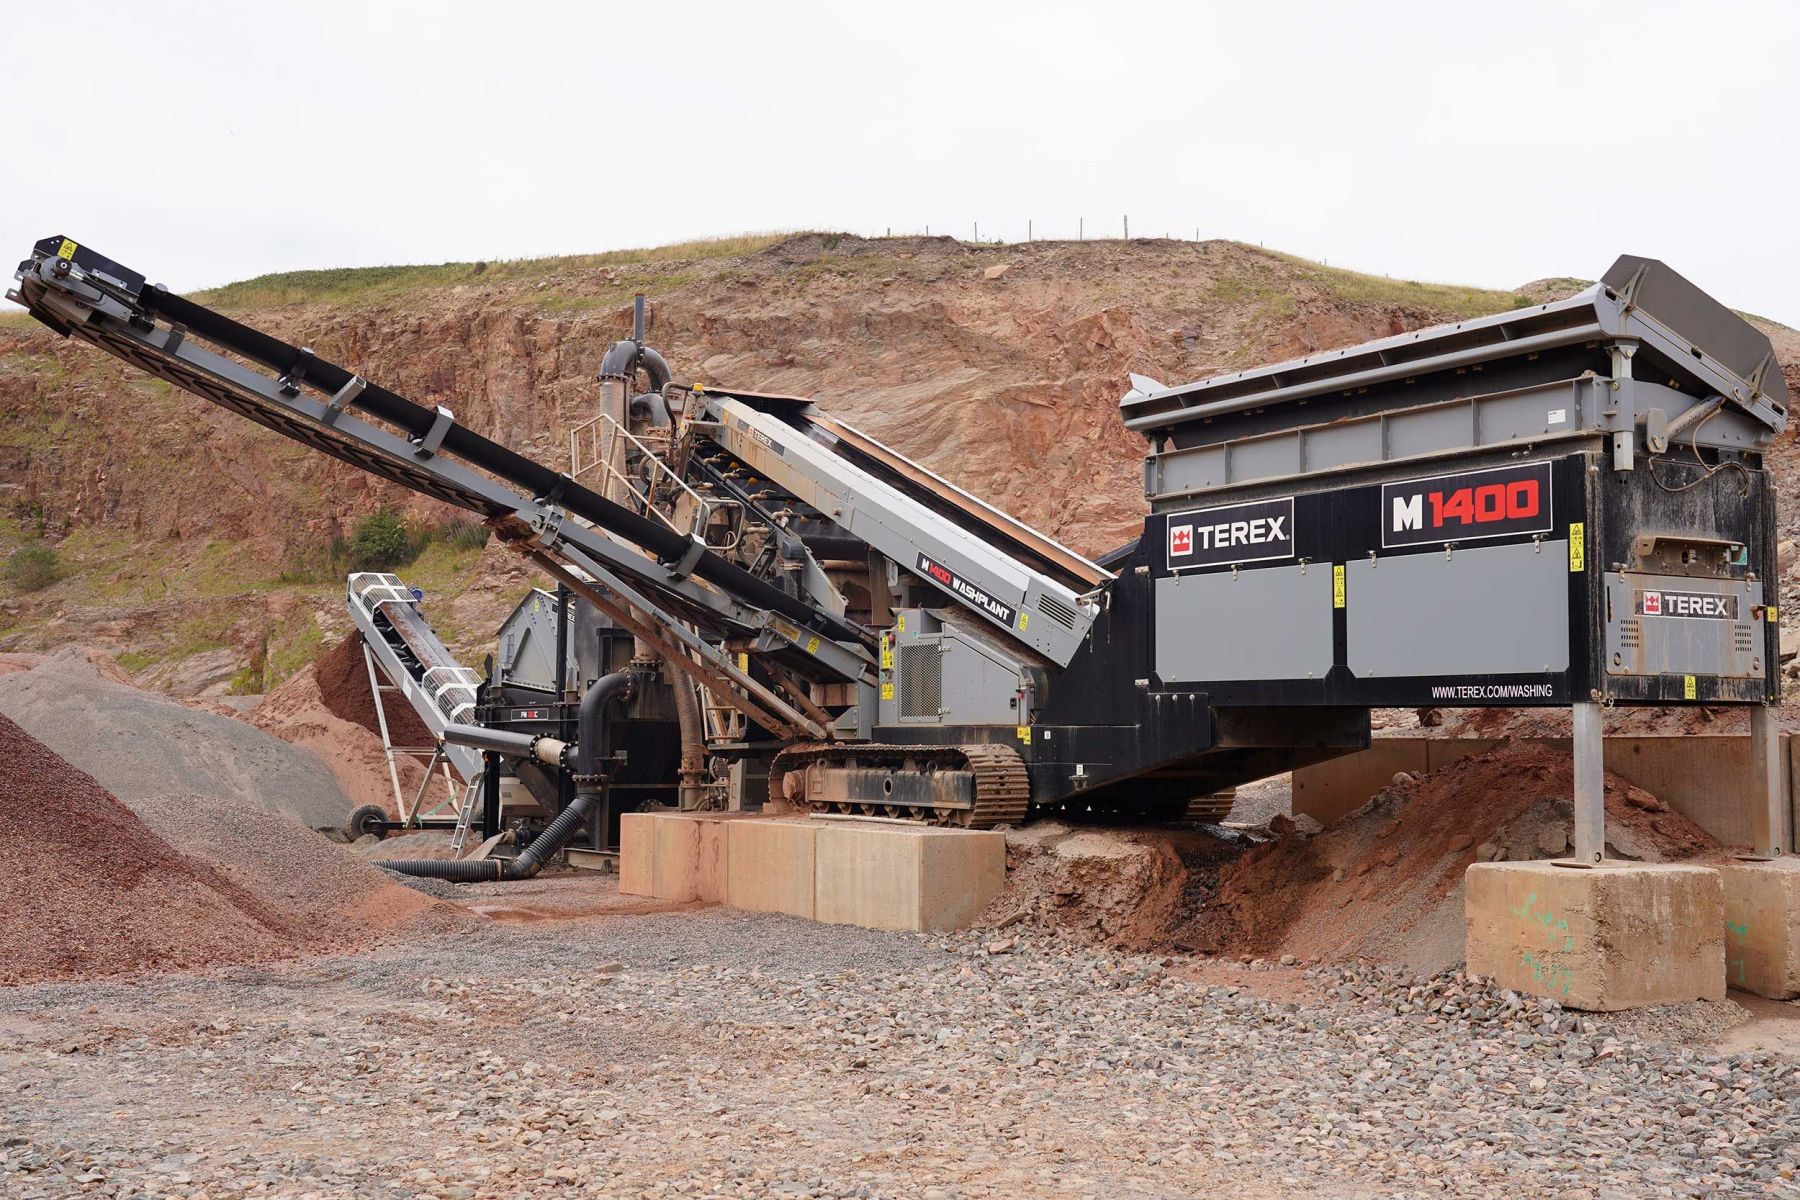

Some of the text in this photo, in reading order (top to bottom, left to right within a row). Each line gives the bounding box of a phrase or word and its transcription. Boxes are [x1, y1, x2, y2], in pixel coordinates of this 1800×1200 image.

[754, 430, 773, 448] TEREX
[1198, 516, 1286, 549] TEREX
[952, 576, 1010, 621] WASHPLANT
[1664, 595, 1728, 616] TEREX
[1431, 684, 1553, 699] WWW.TEREX.COM/WASHING
